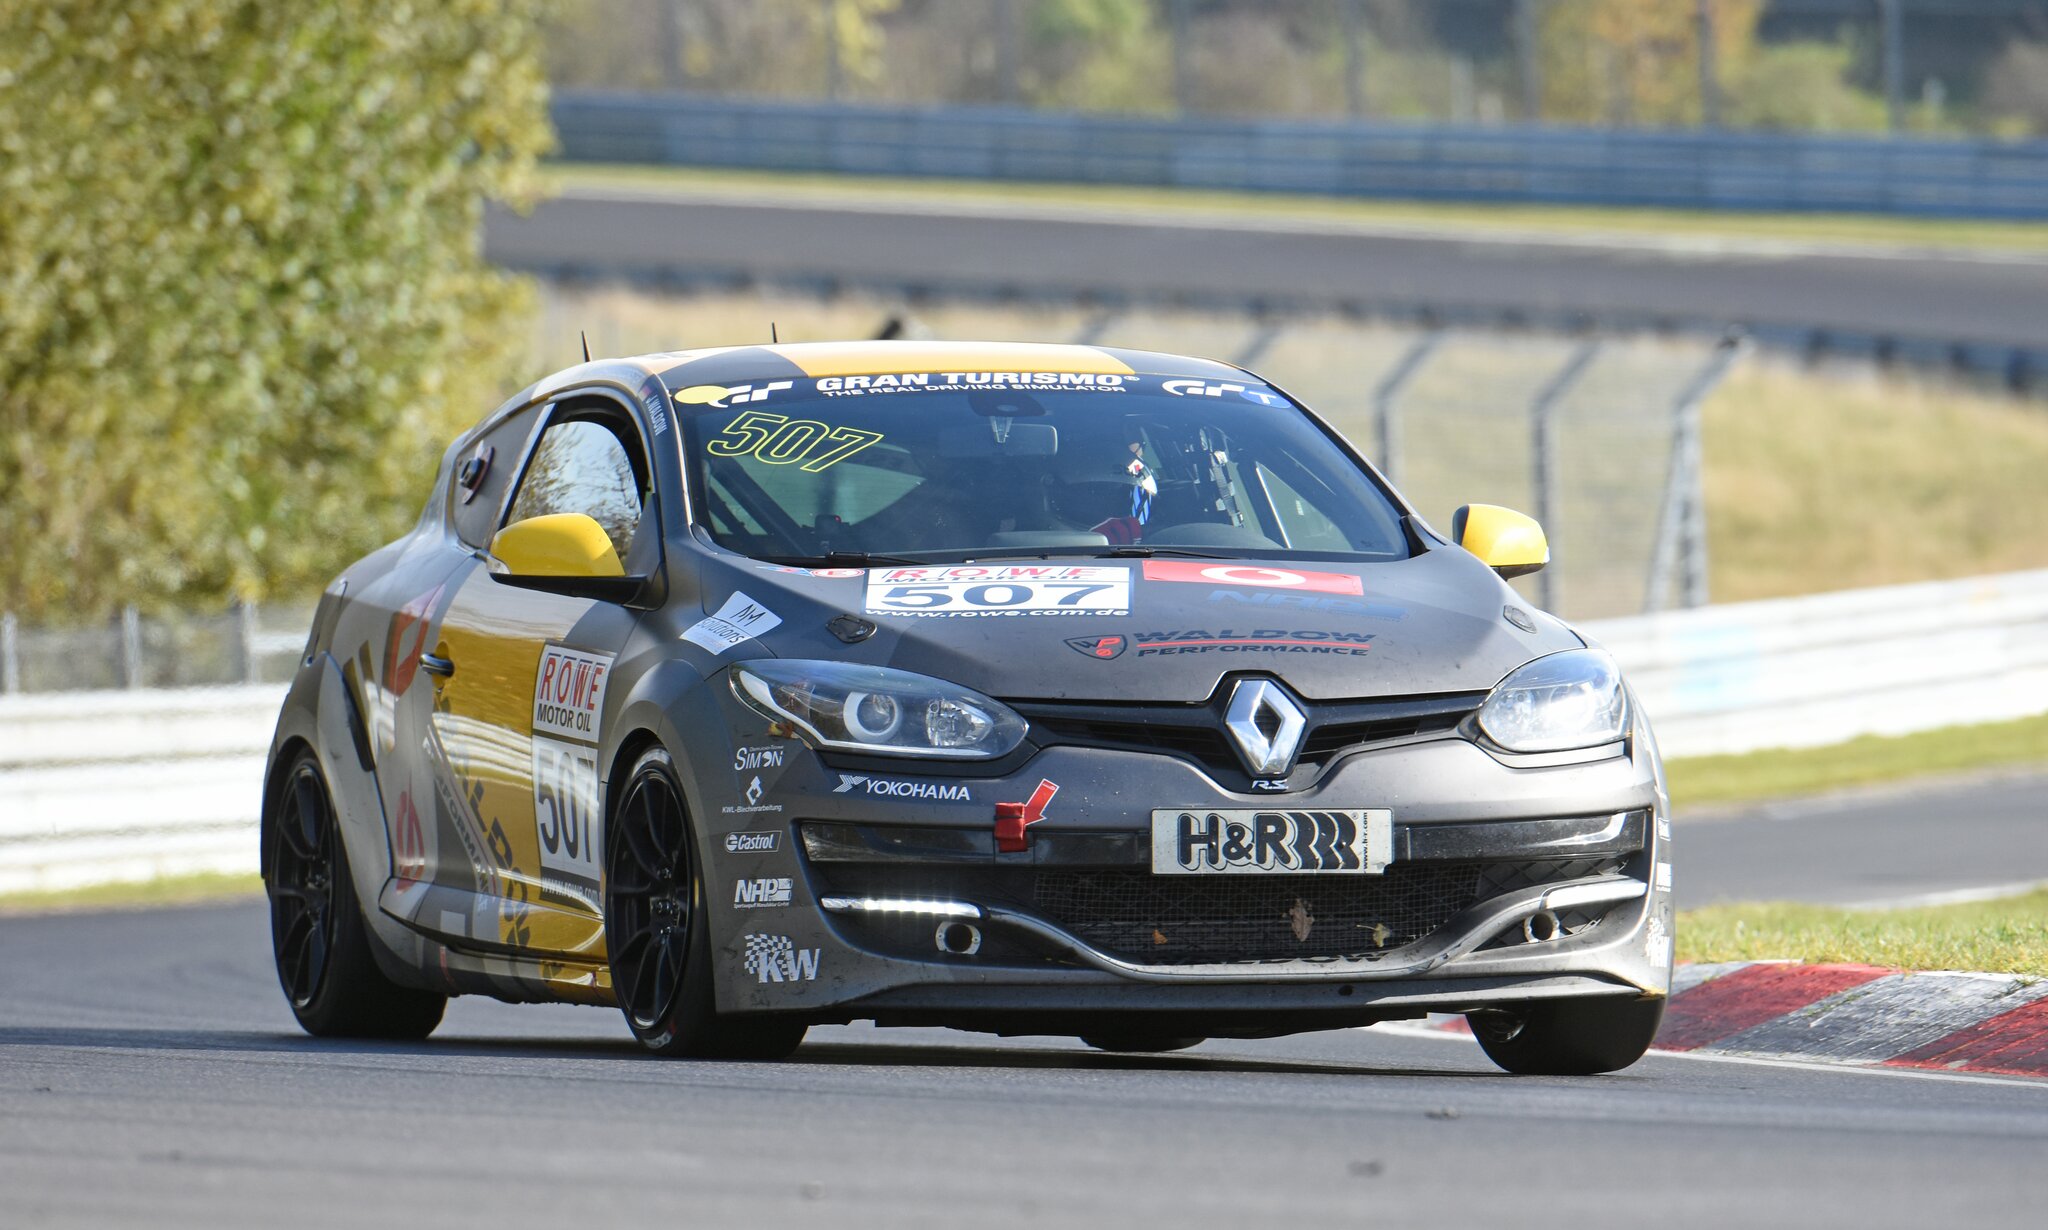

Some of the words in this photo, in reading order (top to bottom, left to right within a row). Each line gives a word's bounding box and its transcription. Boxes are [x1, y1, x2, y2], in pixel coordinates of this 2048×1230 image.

[816, 373, 929, 392] GRAN
[822, 389, 867, 398] THE
[869, 386, 915, 395] REAL
[924, 383, 1008, 392] DRIVING
[1012, 383, 1127, 393] SIMULATOR
[707, 410, 884, 473] 507
[889, 567, 1102, 579] ROWE
[880, 584, 1115, 607] 507
[865, 608, 1130, 618] www.rowe.com.de
[1133, 629, 1377, 643] WALDOW
[1137, 645, 1370, 657] PERFORMANCE
[540, 653, 606, 711] ROWE
[537, 703, 575, 729] MOTOR
[576, 713, 592, 733] OIL
[735, 747, 784, 771] SIMON
[866, 779, 971, 801] YOKOHAMA
[538, 748, 595, 863] 507
[738, 834, 774, 850] Castrol
[758, 948, 821, 983] KW
